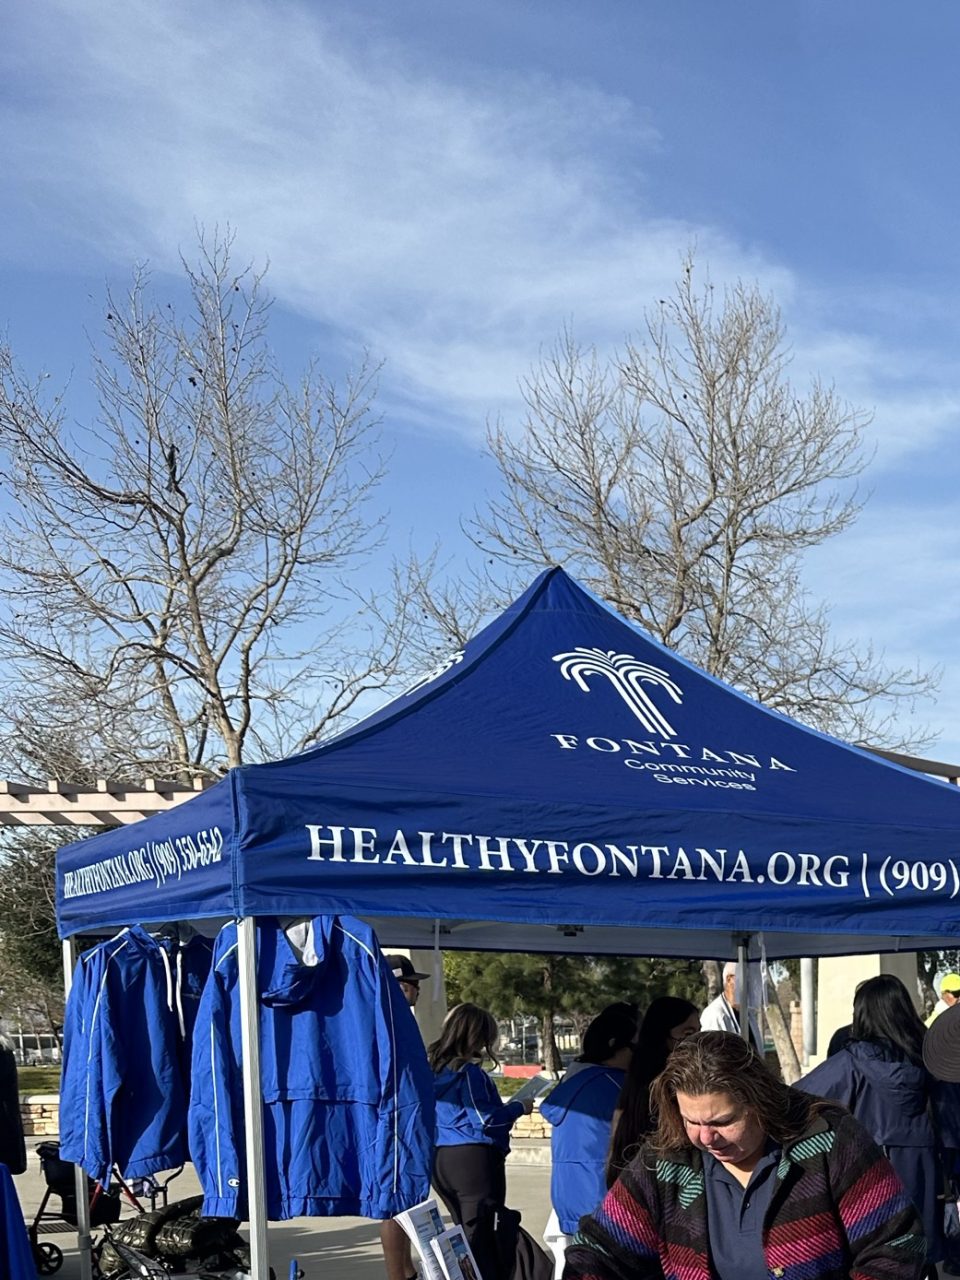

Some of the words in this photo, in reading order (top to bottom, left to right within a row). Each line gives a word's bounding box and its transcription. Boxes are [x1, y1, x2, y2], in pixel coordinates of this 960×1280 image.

[550, 734, 797, 772] FONTANA
[624, 759, 756, 782] Community
[653, 773, 757, 791] Services
[176, 826, 223, 873] 350-6542
[305, 823, 850, 888] HEALTHYFONTANA.ORG
[879, 855, 960, 898] (909)
